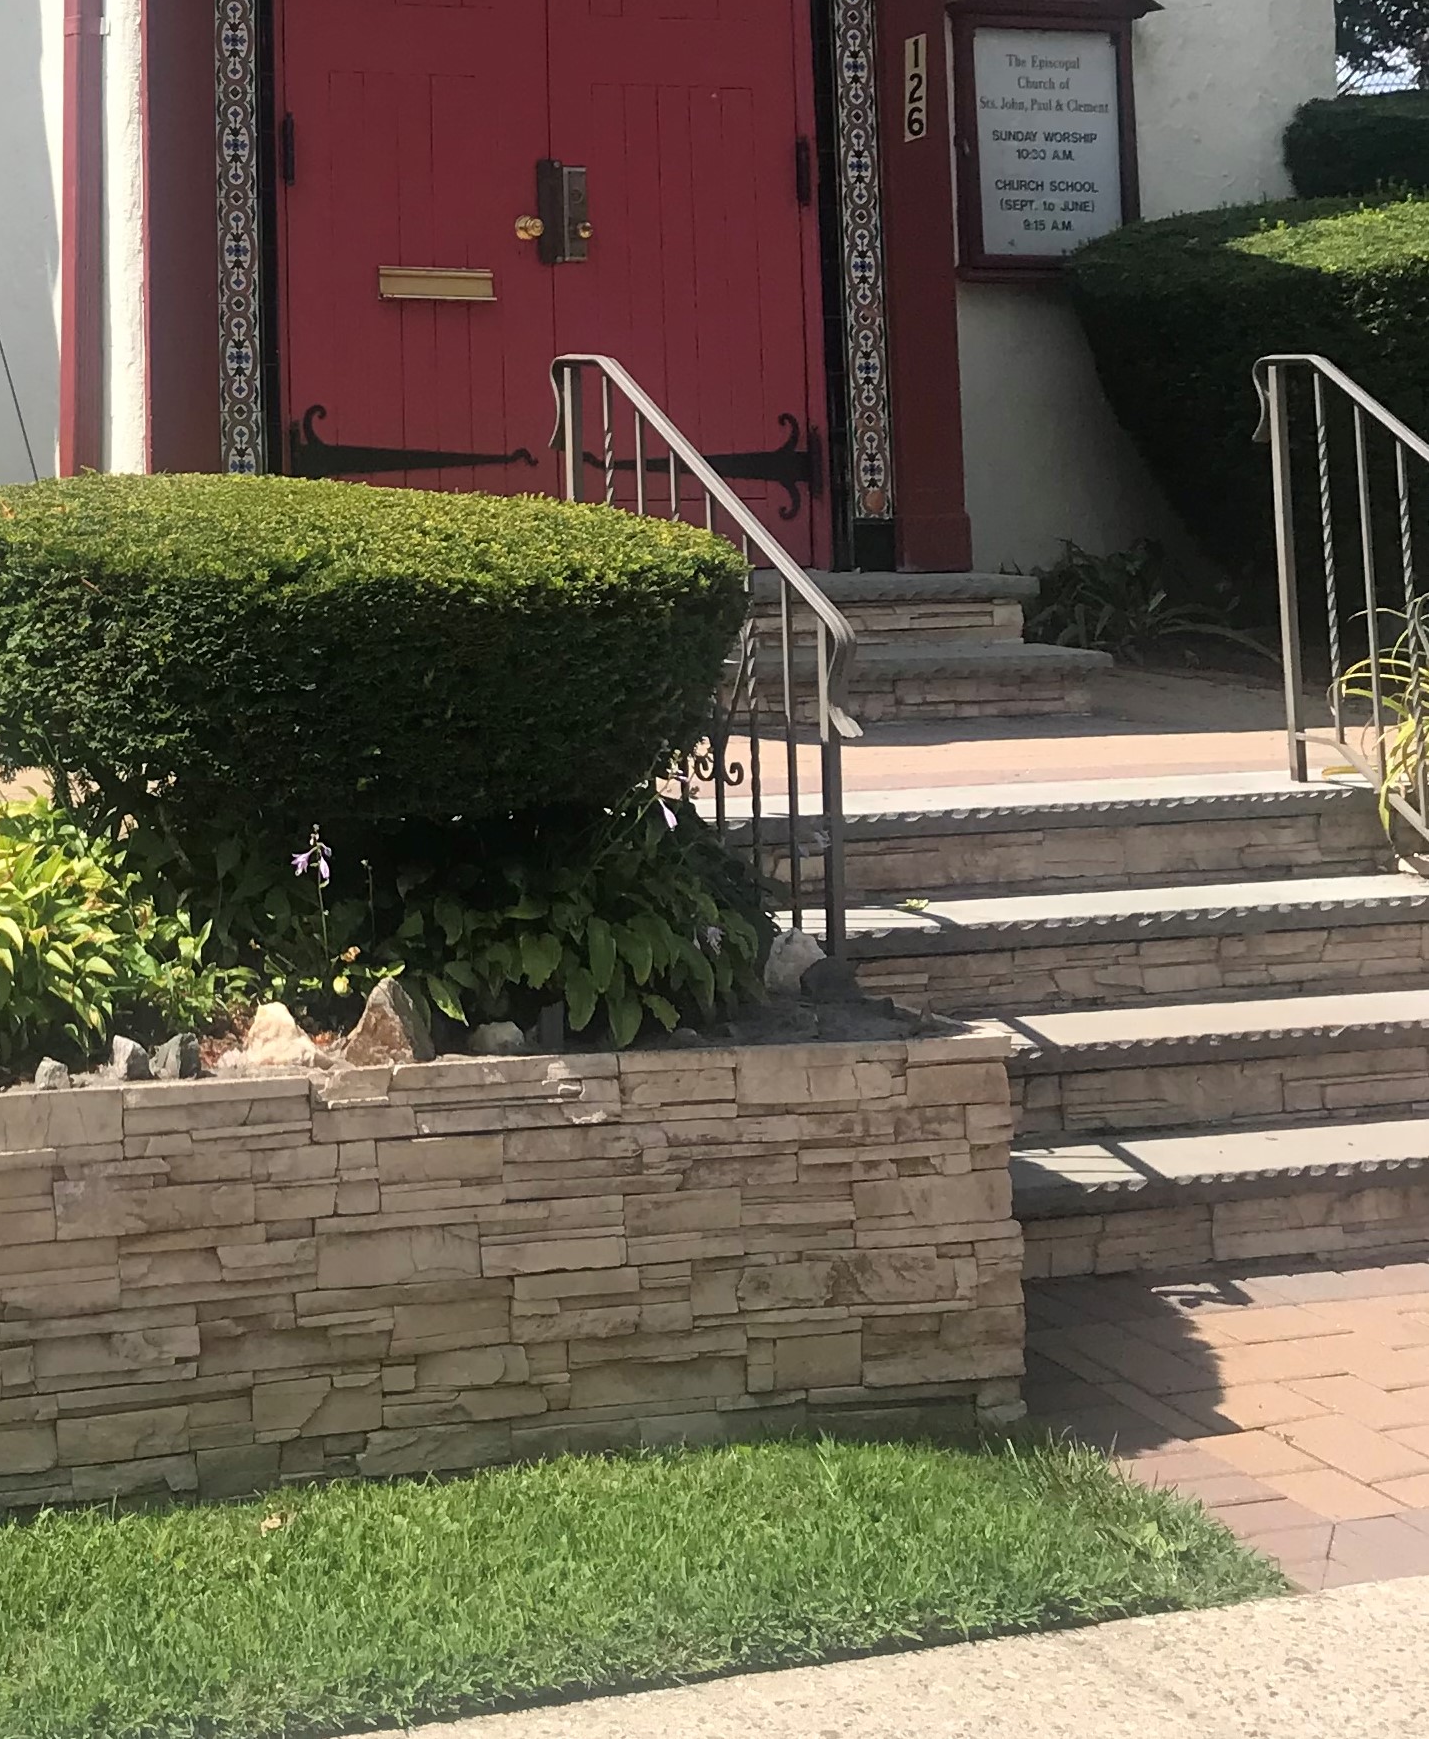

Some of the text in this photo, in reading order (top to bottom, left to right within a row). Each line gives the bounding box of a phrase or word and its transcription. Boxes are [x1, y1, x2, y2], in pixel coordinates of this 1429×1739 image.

[1006, 54, 1081, 71] The Episcopal
[907, 38, 925, 136] 126
[1017, 76, 1070, 90] Church of
[979, 98, 1109, 114] Sts. John, Paul & Clement
[992, 130, 1097, 144] SUNDAY WORSHIP
[1016, 148, 1047, 161] 10:30
[995, 180, 1098, 193] CHURCH SCHOOL
[1060, 200, 1094, 213] JUNE)
